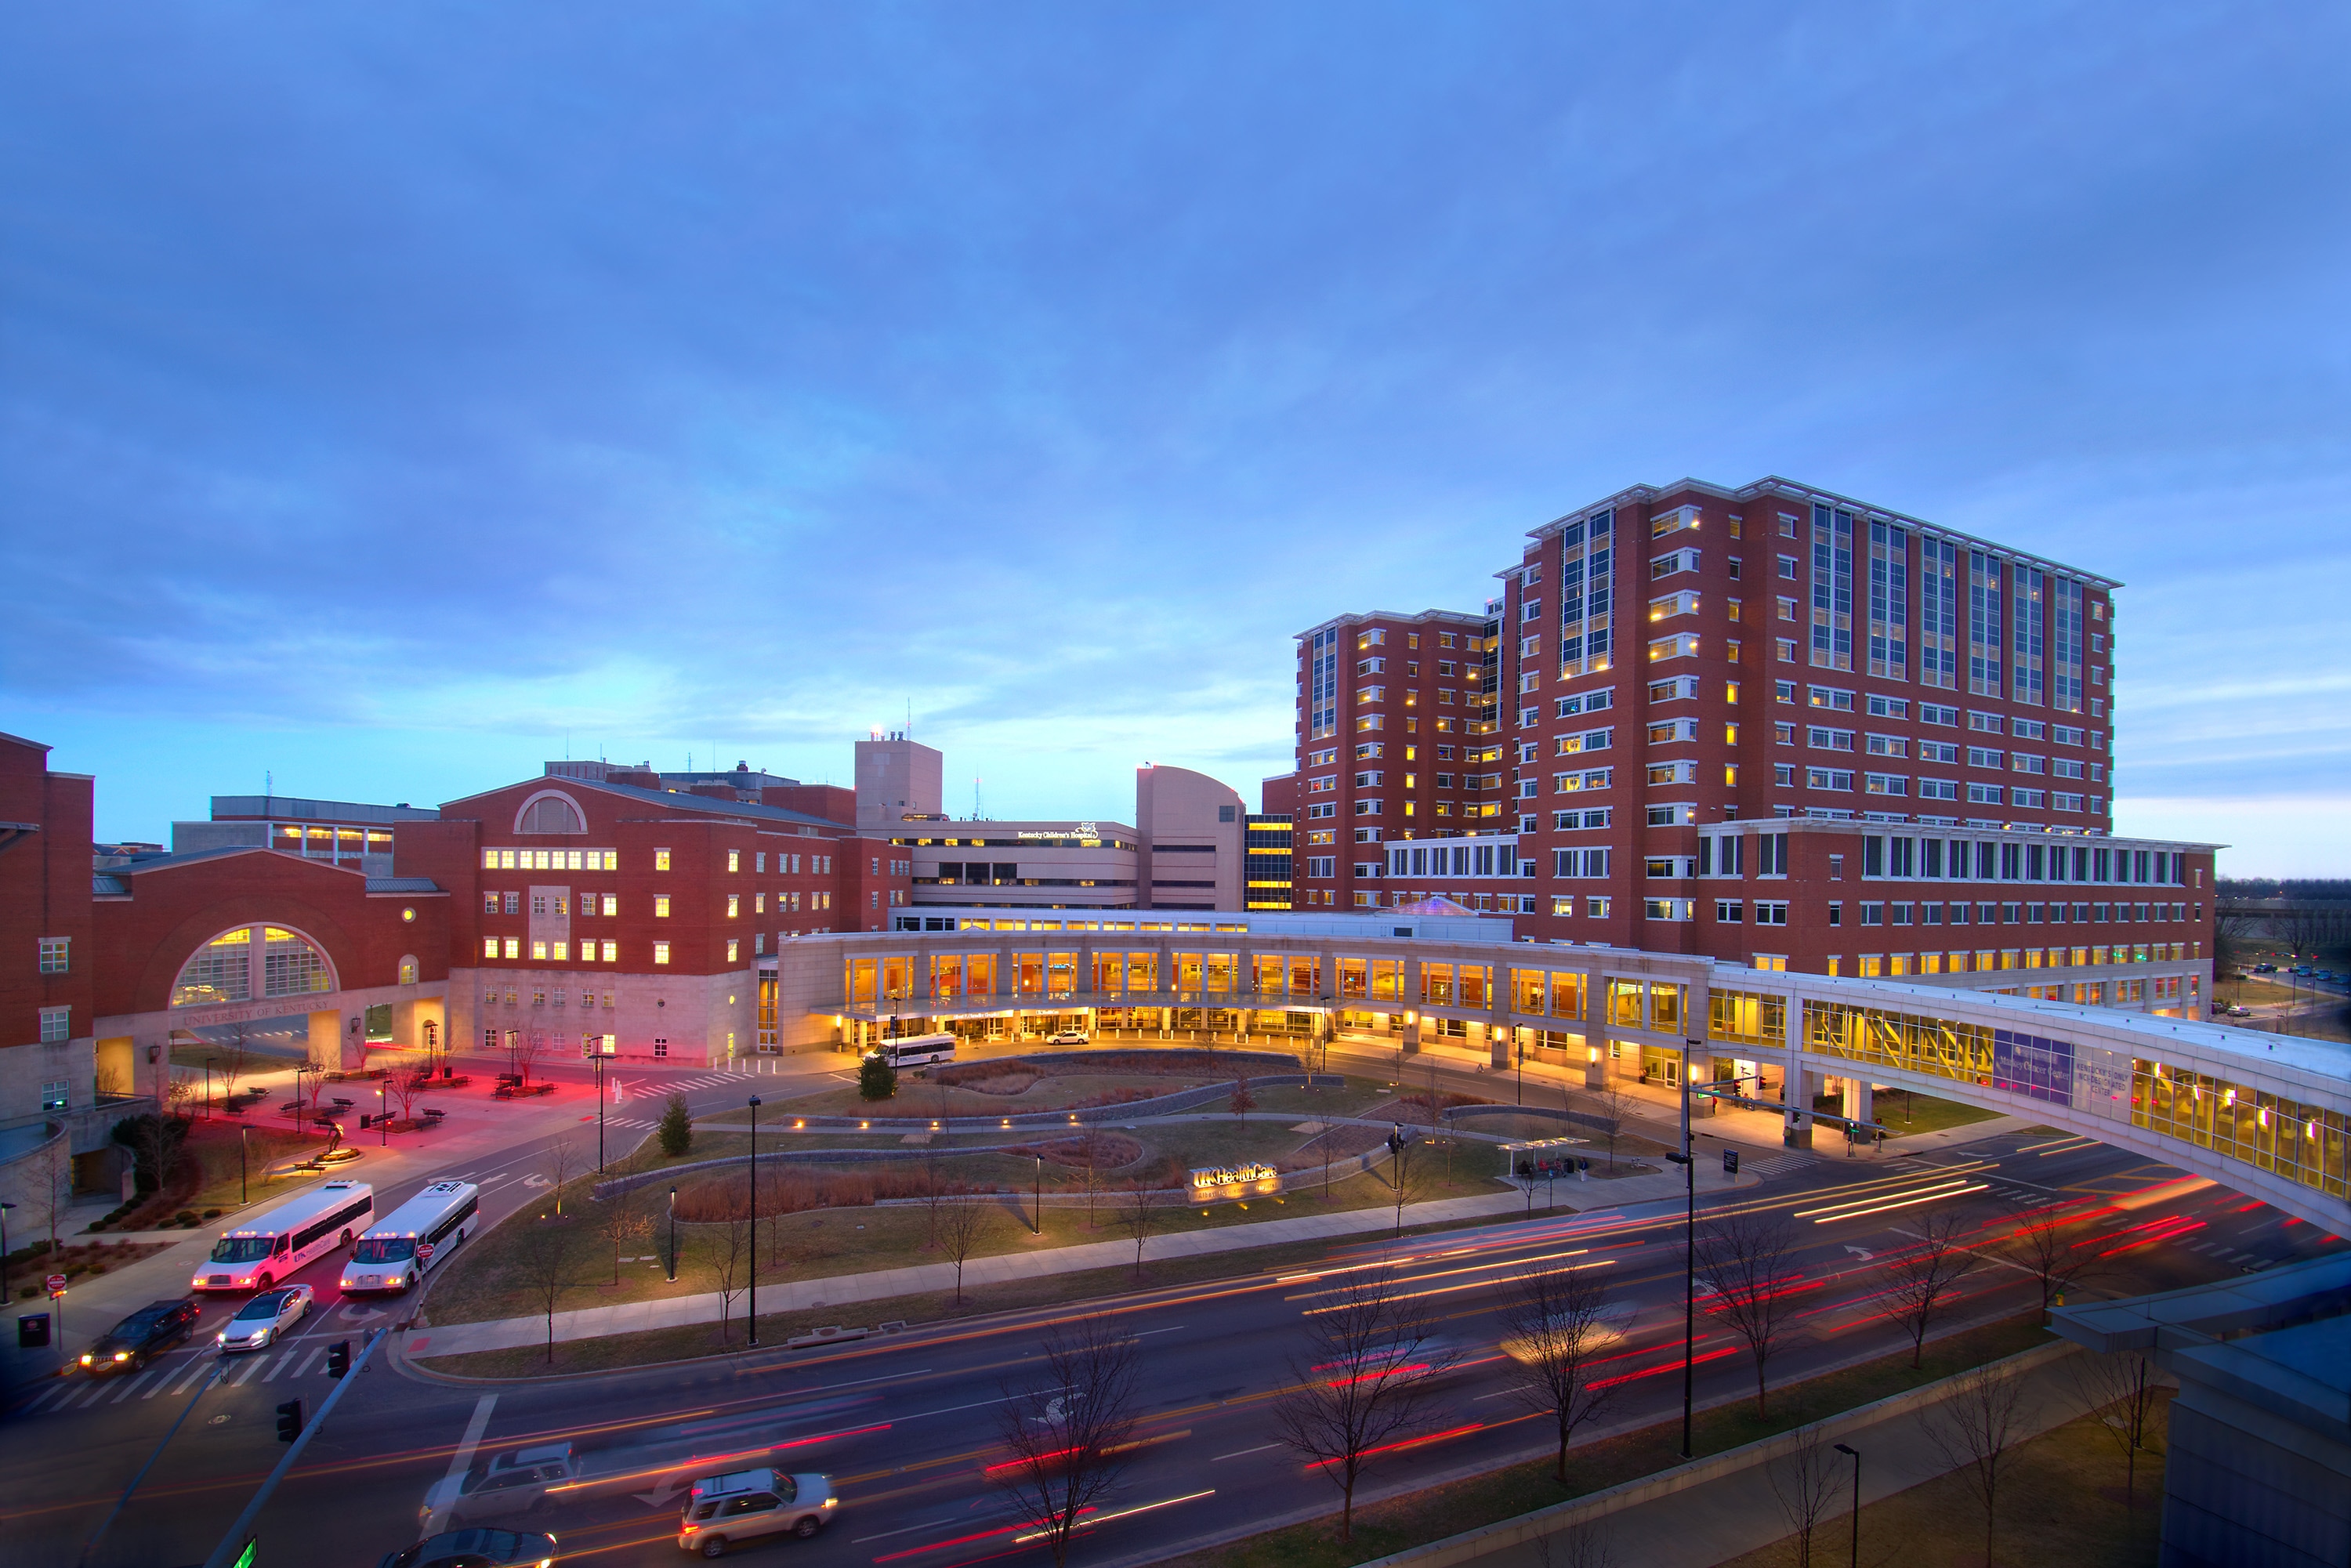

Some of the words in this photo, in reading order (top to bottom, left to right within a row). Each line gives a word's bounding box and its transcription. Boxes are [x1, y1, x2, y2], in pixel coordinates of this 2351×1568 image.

[1018, 831, 1042, 840] Kentucky
[1070, 831, 1092, 840] Hospital
[183, 1009, 252, 1026] UNIVERSITY
[257, 1008, 270, 1016] OF
[275, 1001, 328, 1015] KENTUCKY
[1999, 1056, 2023, 1071] Markey
[2023, 1061, 2047, 1074] Cancer
[2048, 1066, 2070, 1081] Center
[2077, 1063, 2111, 1077] KENTUCKY'S
[2114, 1072, 2129, 1081] ONLY
[2078, 1073, 2126, 1092] NCI-DESIGNATED
[2092, 1085, 2110, 1096] CENTER
[294, 1251, 306, 1262] UK
